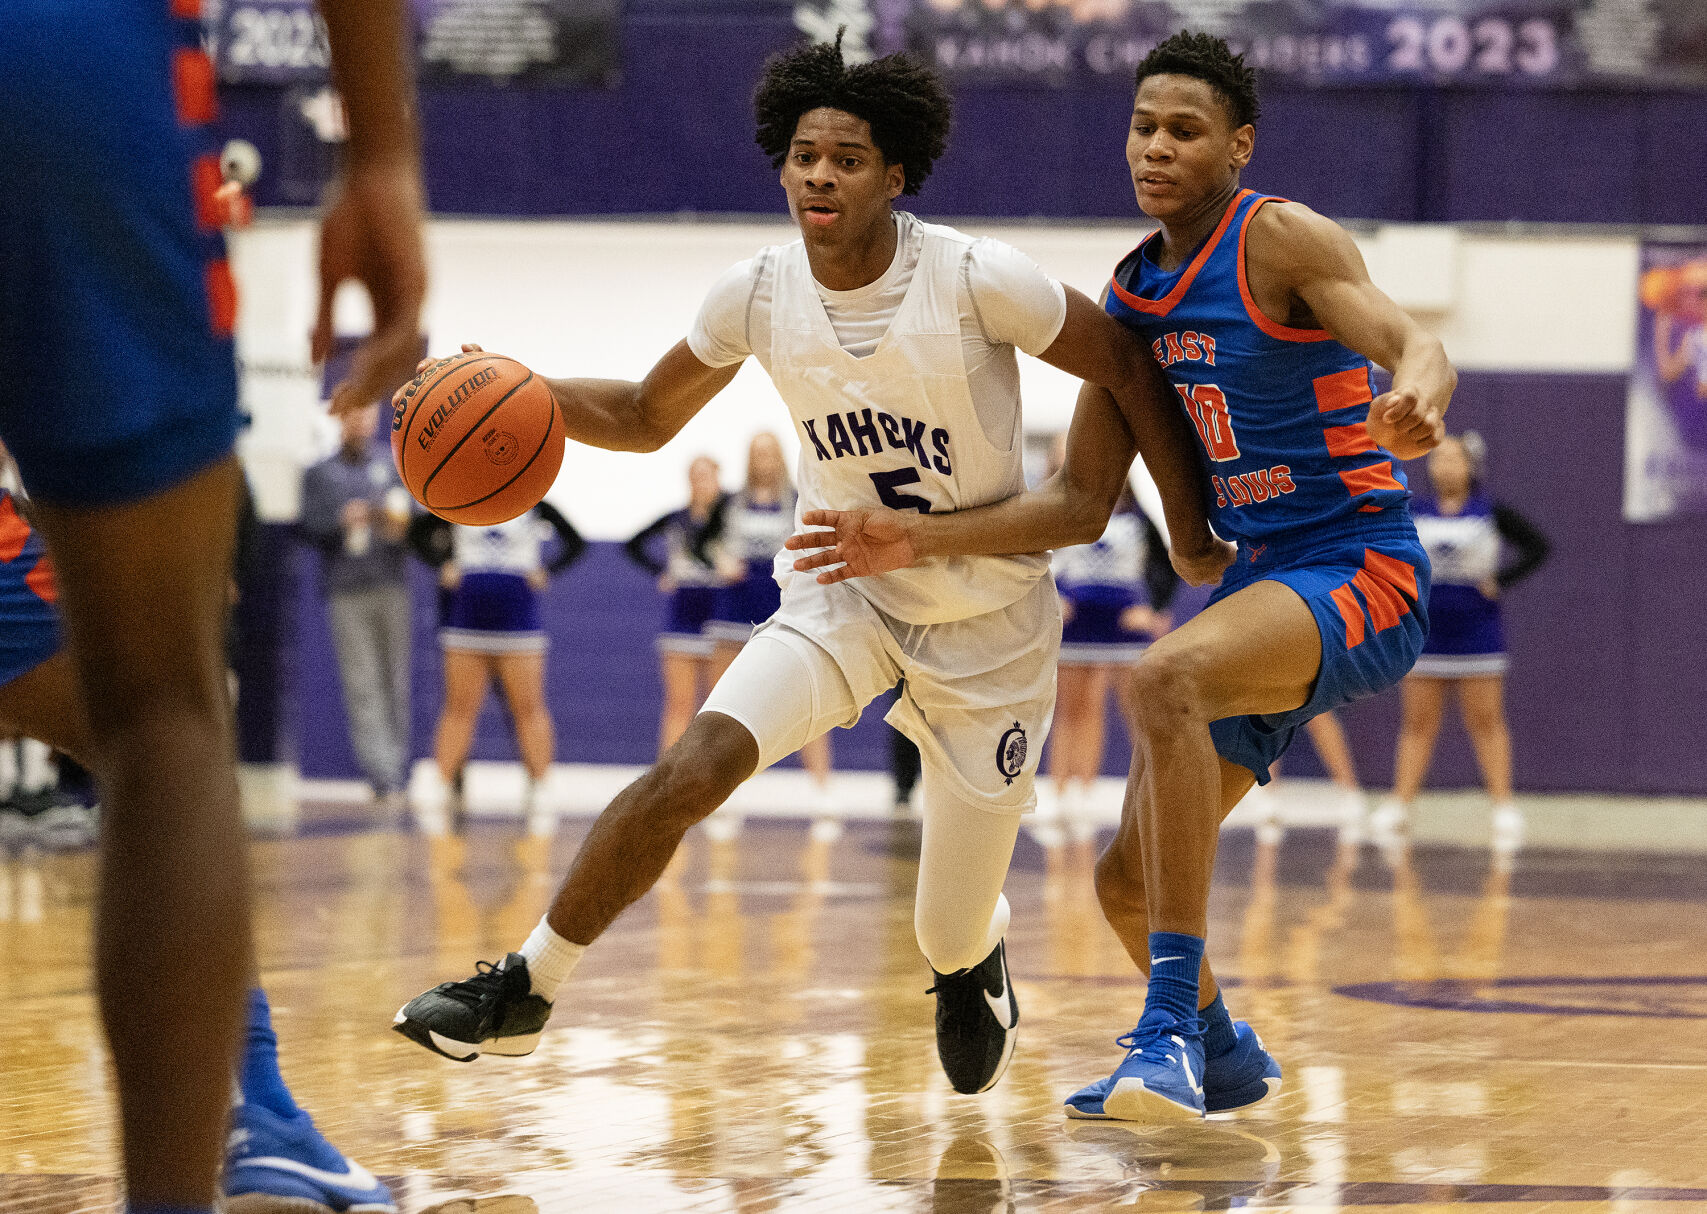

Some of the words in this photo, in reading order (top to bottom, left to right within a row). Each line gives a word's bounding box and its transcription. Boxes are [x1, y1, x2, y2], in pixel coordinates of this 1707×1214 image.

[1386, 18, 1557, 75] 2023
[1152, 331, 1216, 369] EAST
[417, 366, 498, 450] EVOLUTION
[802, 408, 952, 476] KAHOKS
[869, 467, 931, 514] 5
